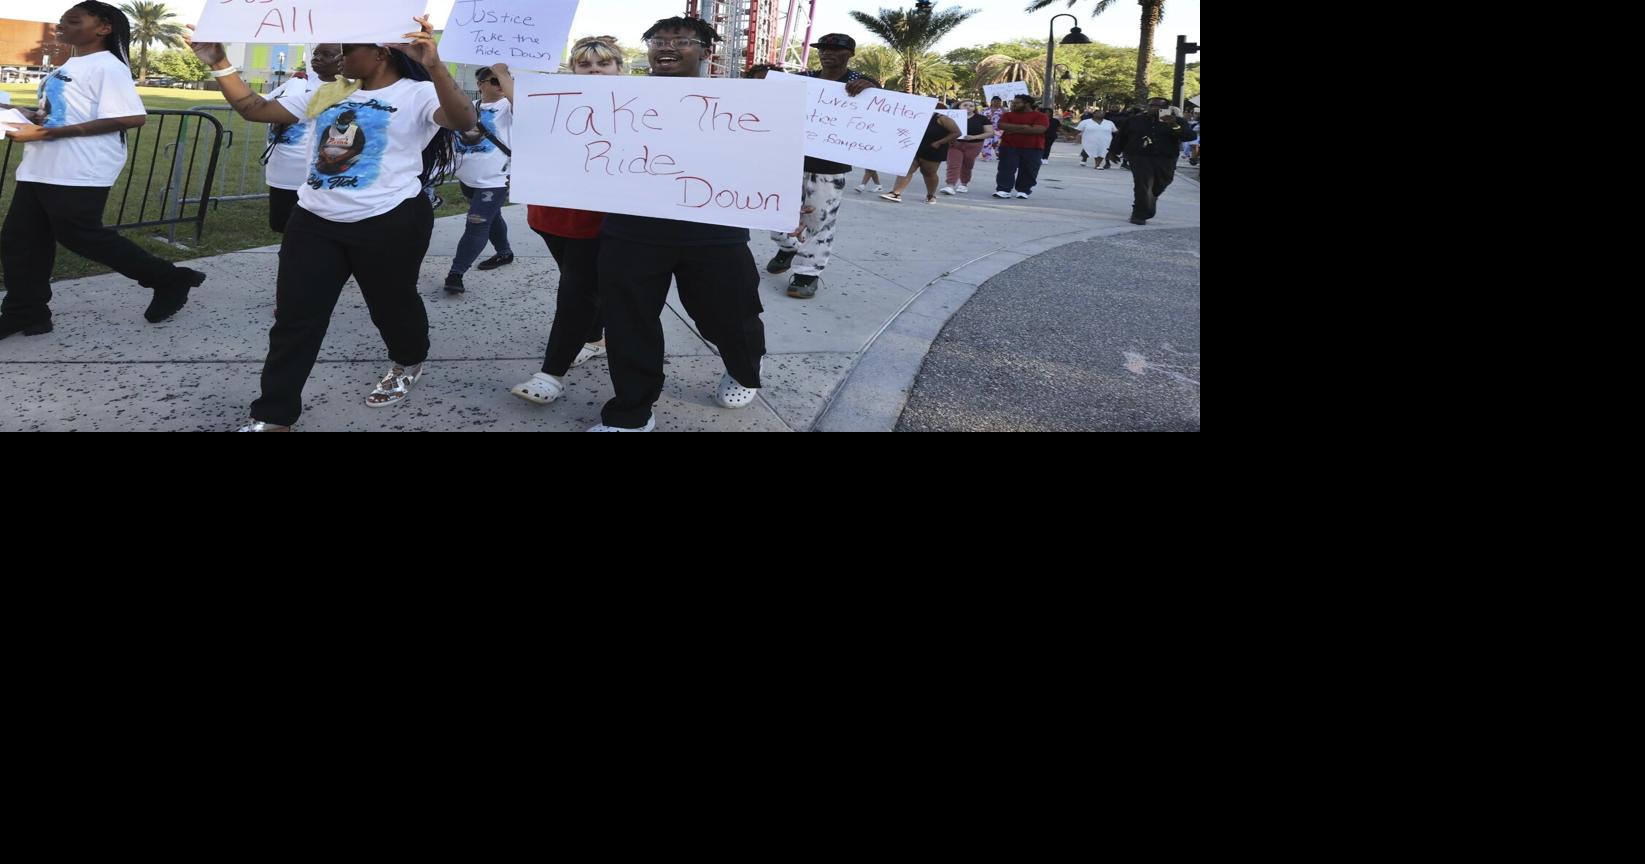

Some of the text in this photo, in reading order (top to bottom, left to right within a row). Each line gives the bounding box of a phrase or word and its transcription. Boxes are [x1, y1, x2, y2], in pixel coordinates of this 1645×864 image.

[253, 6, 314, 38] All
[475, 45, 552, 61] Ride Down
[679, 93, 771, 133] The
[866, 95, 926, 120] Matter
[584, 140, 781, 212] Ride Down
